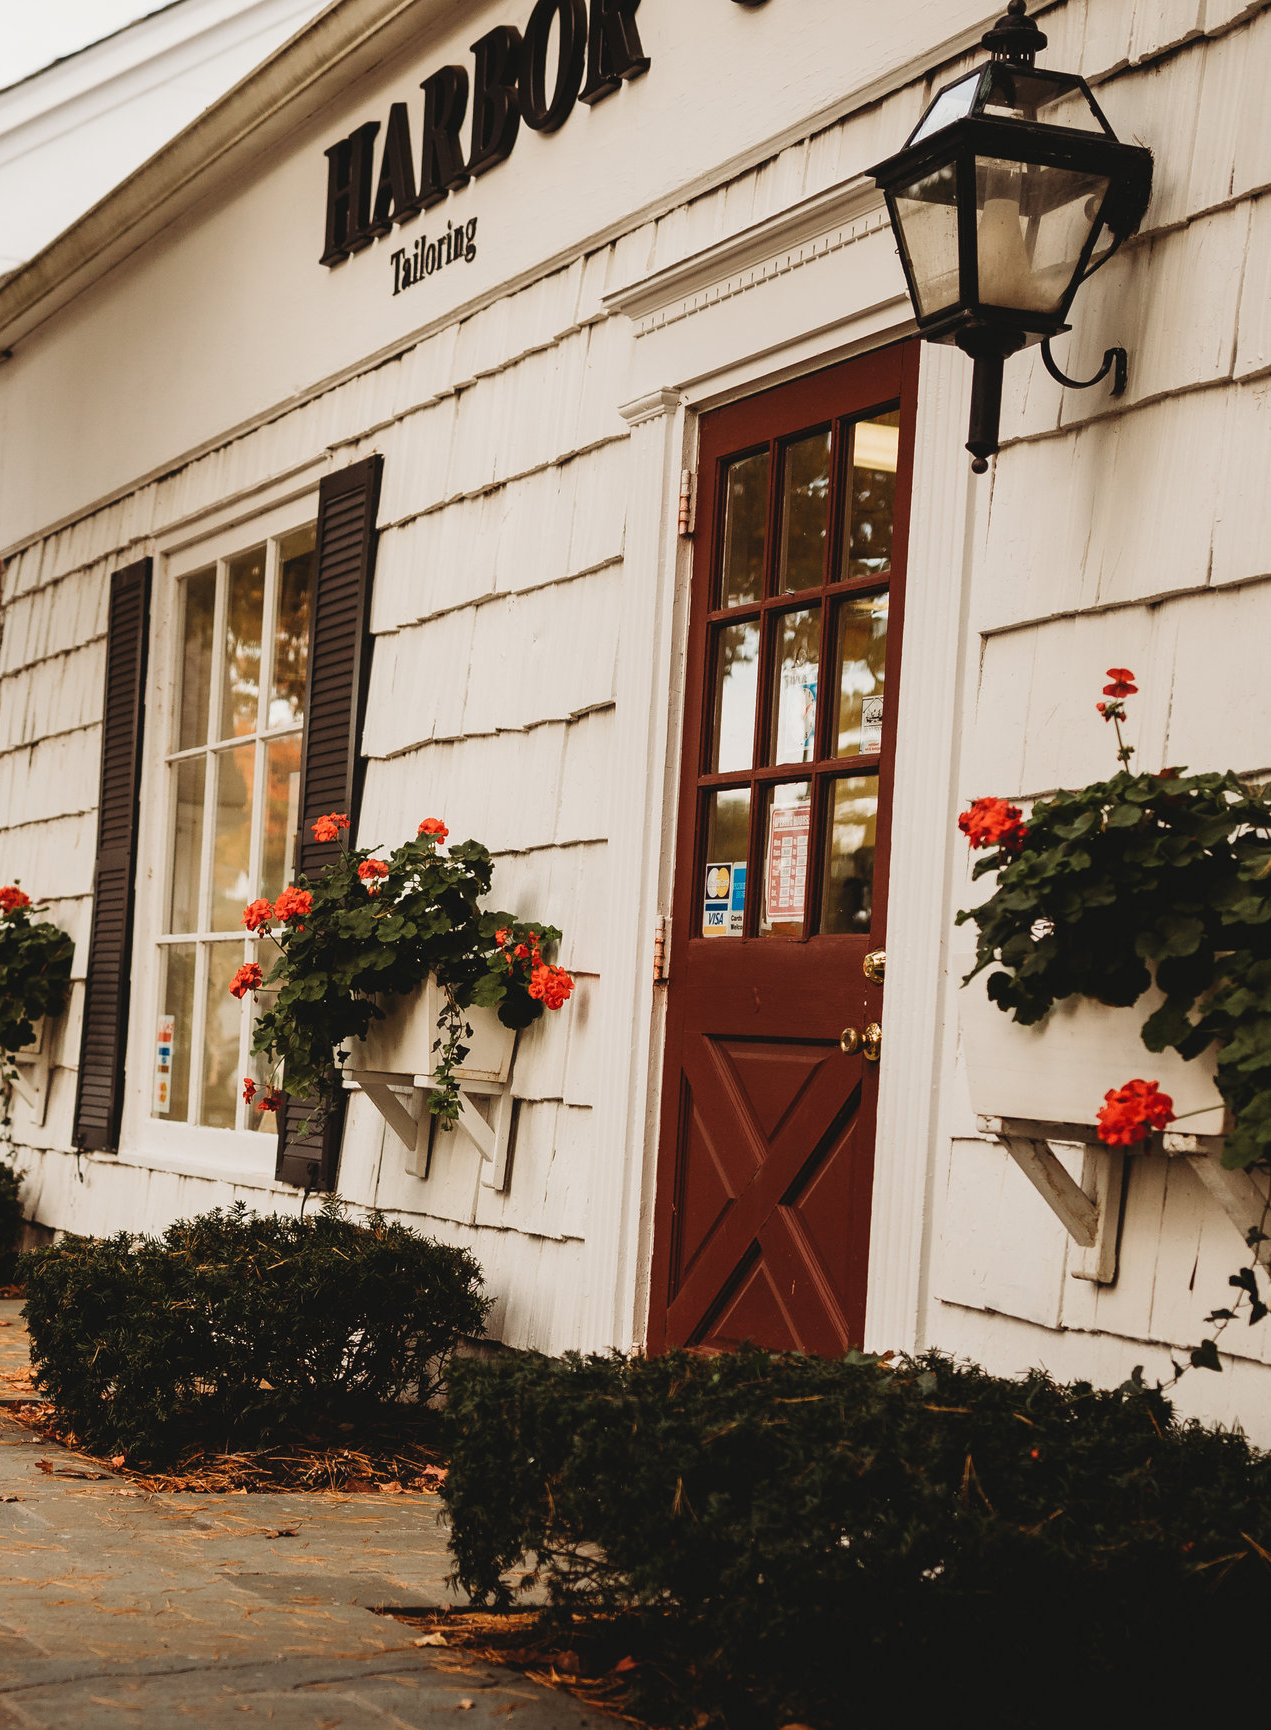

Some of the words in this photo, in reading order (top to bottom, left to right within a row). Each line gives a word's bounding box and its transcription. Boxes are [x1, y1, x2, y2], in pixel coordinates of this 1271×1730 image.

[319, 0, 651, 268] HARBOR
[390, 216, 478, 296] Tailoring
[708, 912, 724, 926] VISA
[730, 914, 742, 922] Cards
